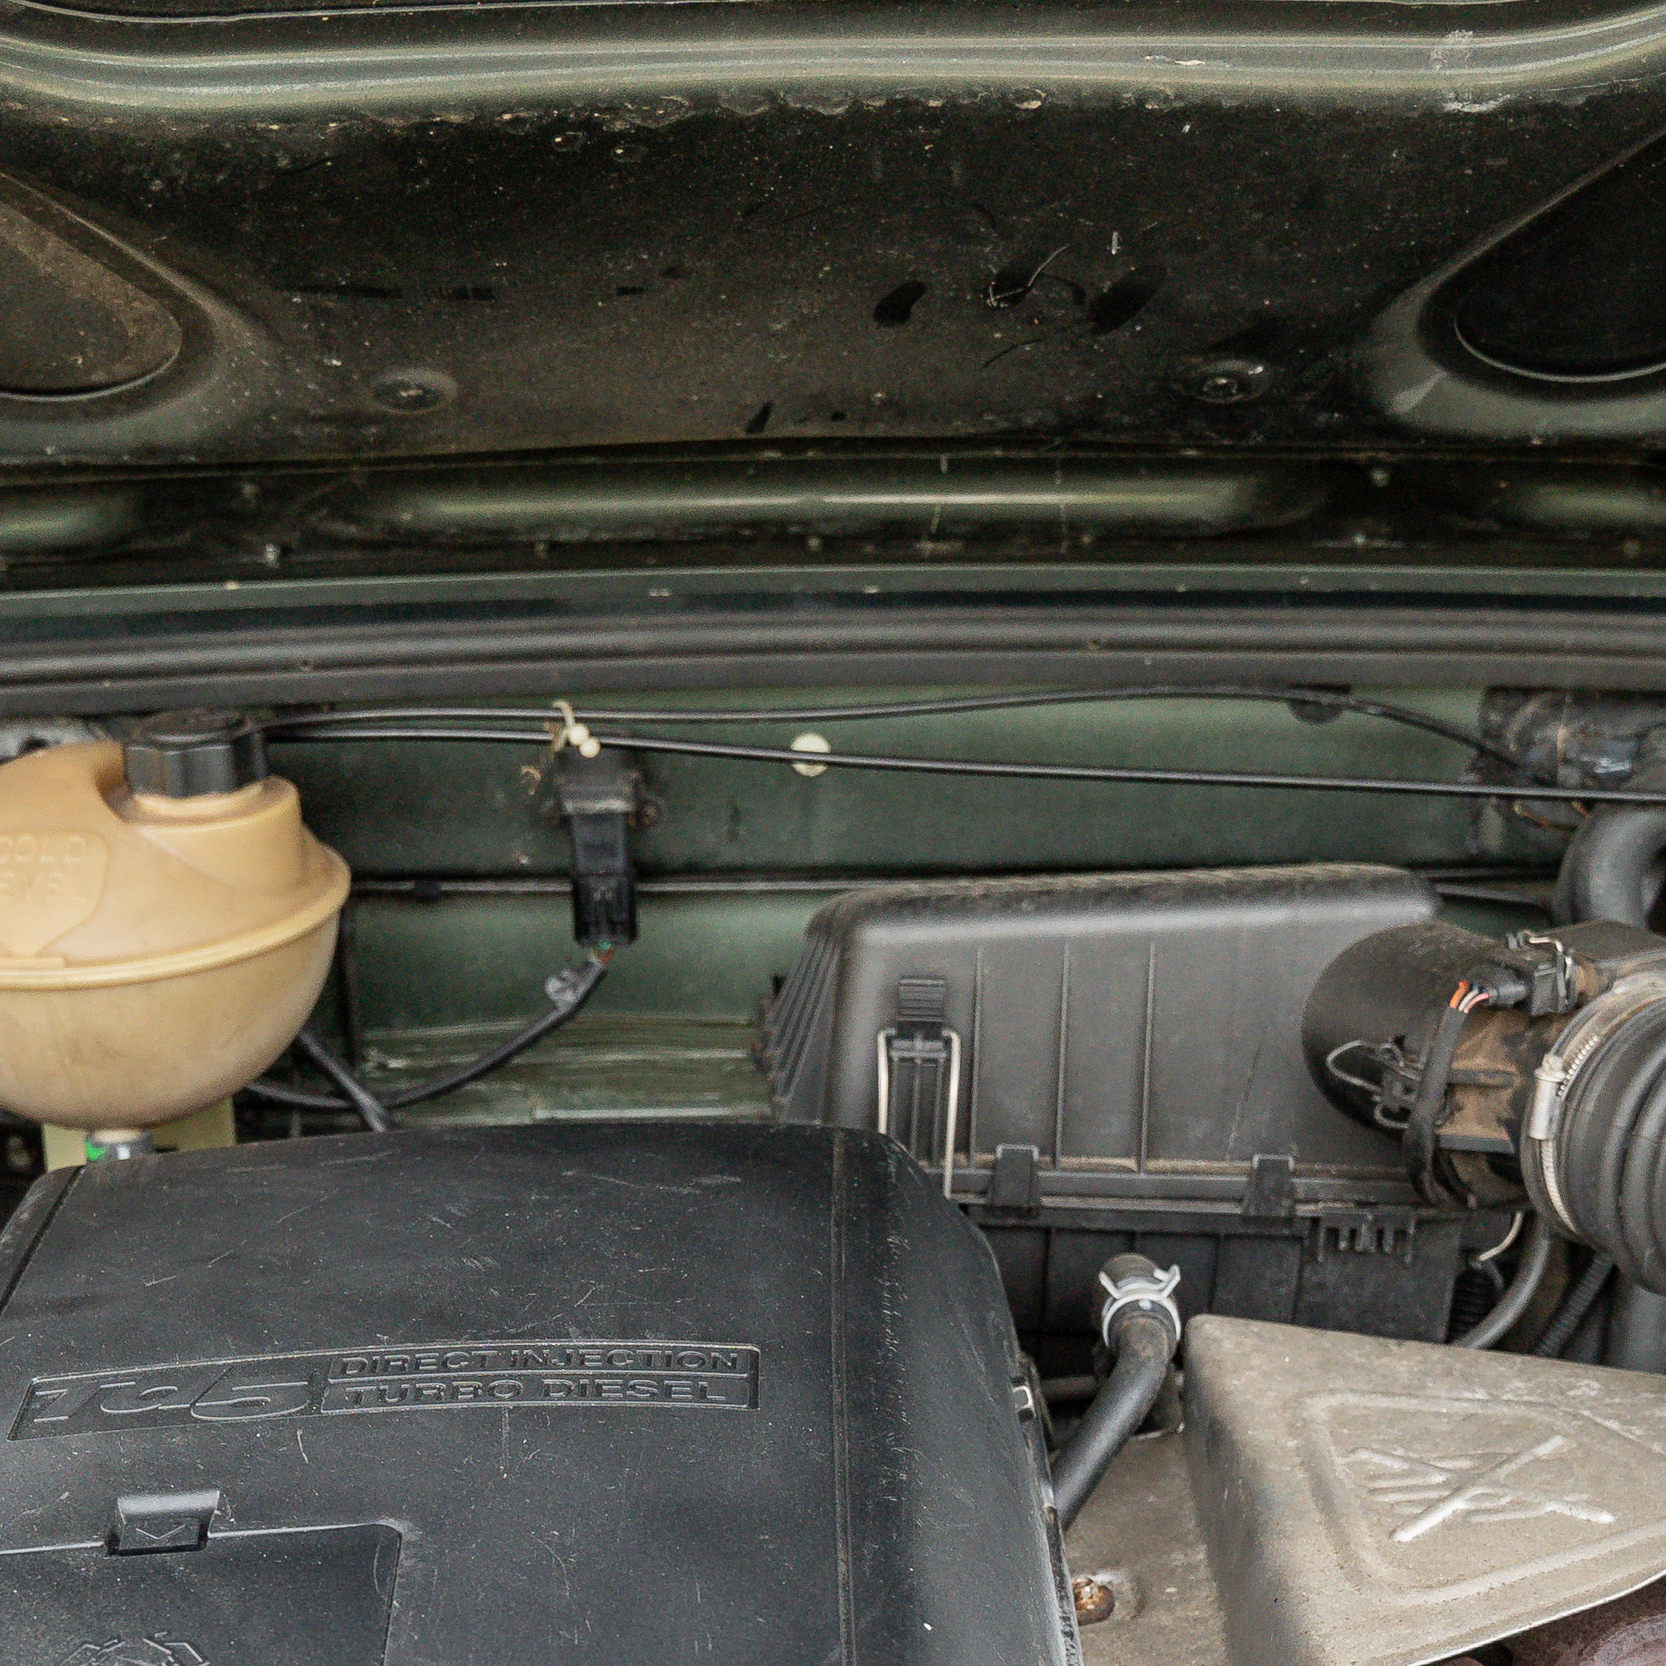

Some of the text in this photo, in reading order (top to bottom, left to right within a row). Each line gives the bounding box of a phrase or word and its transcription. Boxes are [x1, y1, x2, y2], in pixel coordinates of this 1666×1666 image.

[341, 1348, 738, 1376] DIRECT INJECTION
[344, 1378, 726, 1405] TURBO DIESEL
